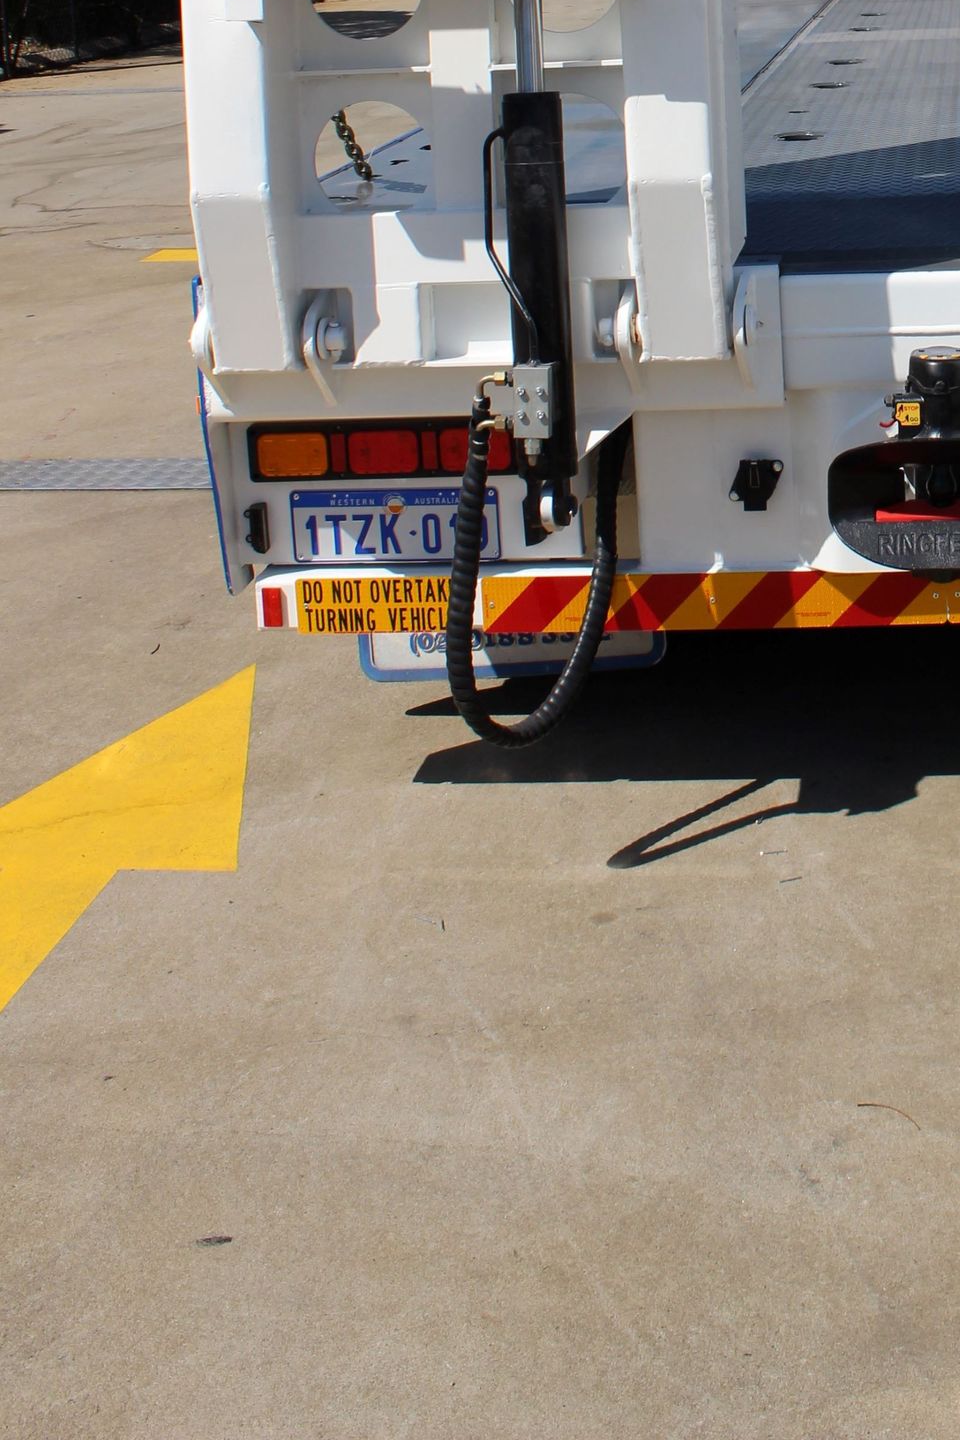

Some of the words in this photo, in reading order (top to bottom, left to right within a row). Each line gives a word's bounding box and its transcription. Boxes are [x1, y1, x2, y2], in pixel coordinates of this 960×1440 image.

[330, 498, 375, 507] WESTERN
[414, 497, 460, 505] AUSTRALIA
[303, 580, 323, 604] DO
[332, 579, 361, 603] NOT
[370, 578, 453, 603] OVERTAK
[306, 608, 376, 632] TURNING
[388, 607, 447, 631] VEHICL
